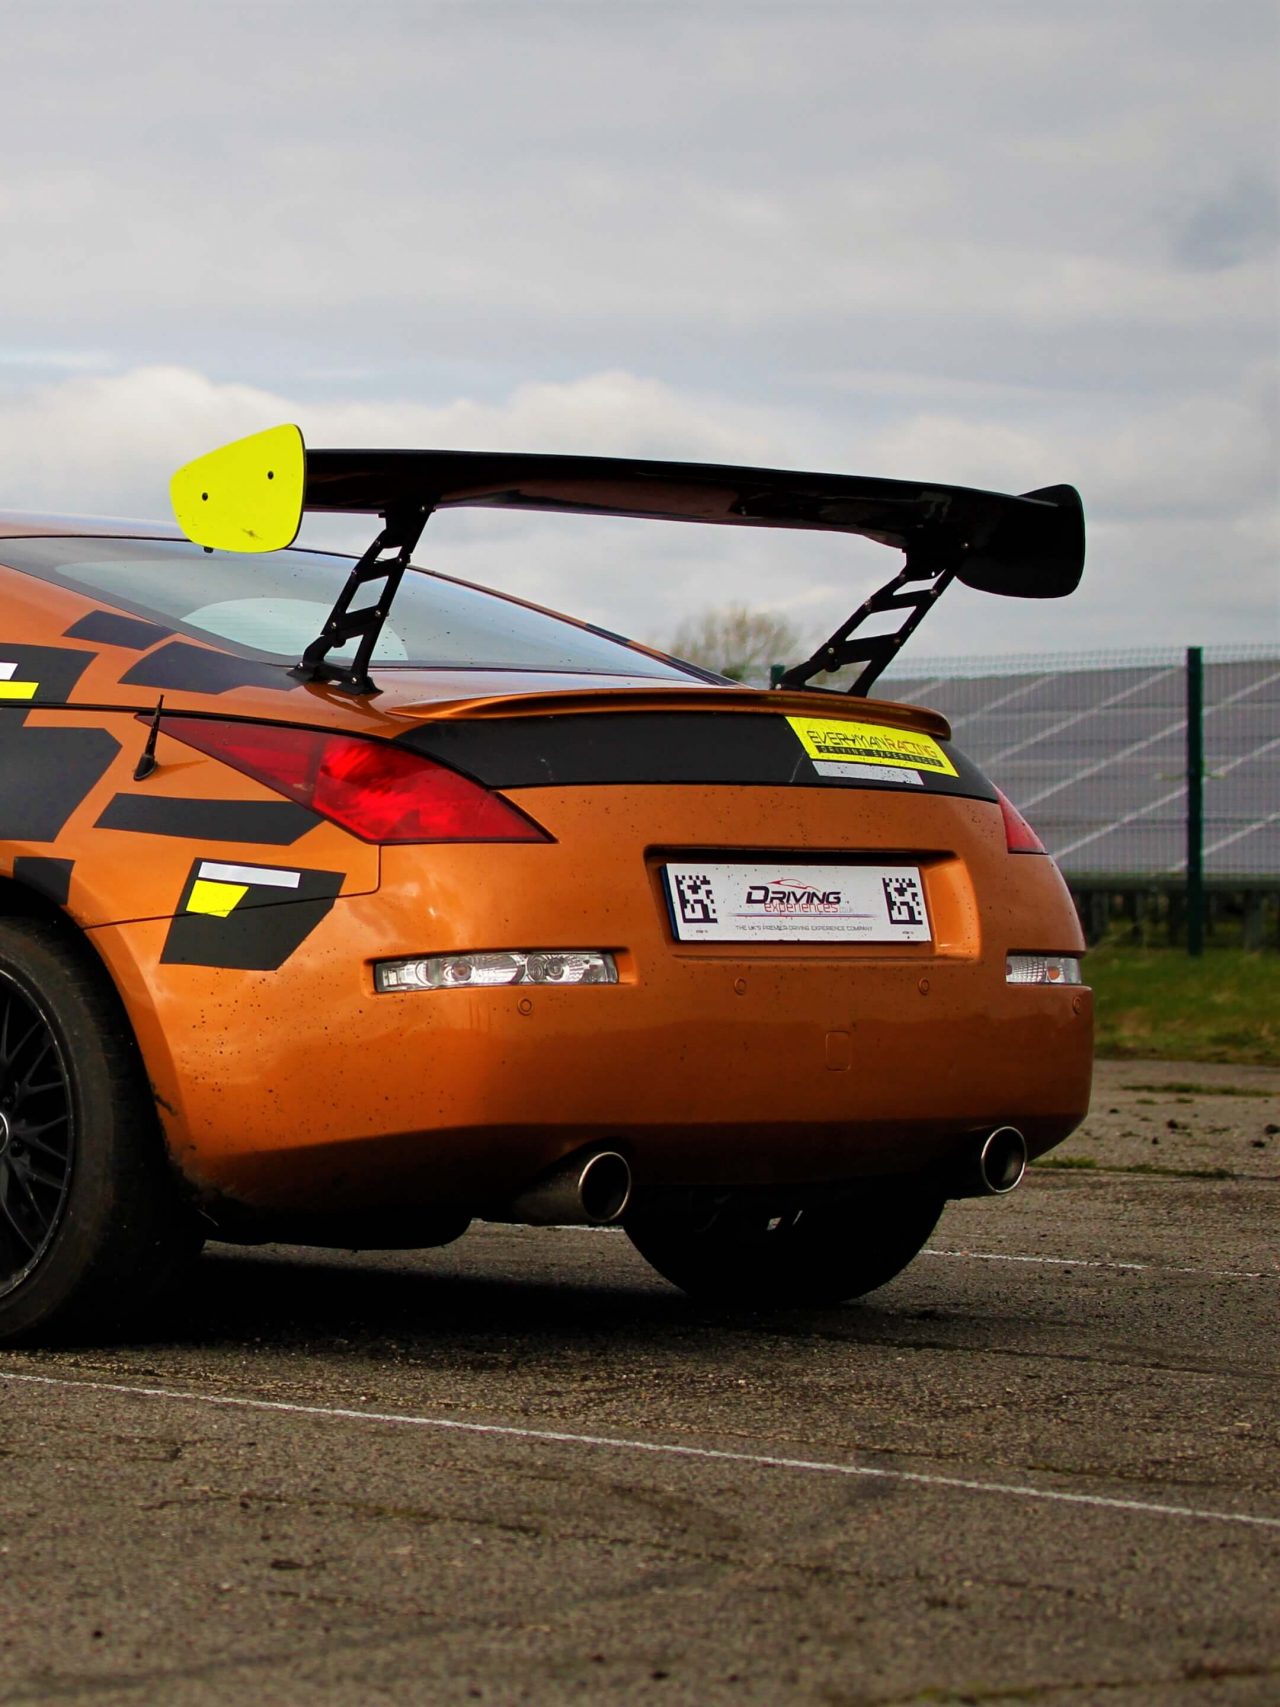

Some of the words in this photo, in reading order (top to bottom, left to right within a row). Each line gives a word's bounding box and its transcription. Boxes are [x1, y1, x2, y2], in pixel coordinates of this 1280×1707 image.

[821, 746, 866, 756] DRIVING
[873, 749, 941, 766] EXPERIENCES
[746, 886, 841, 904] DRIVING
